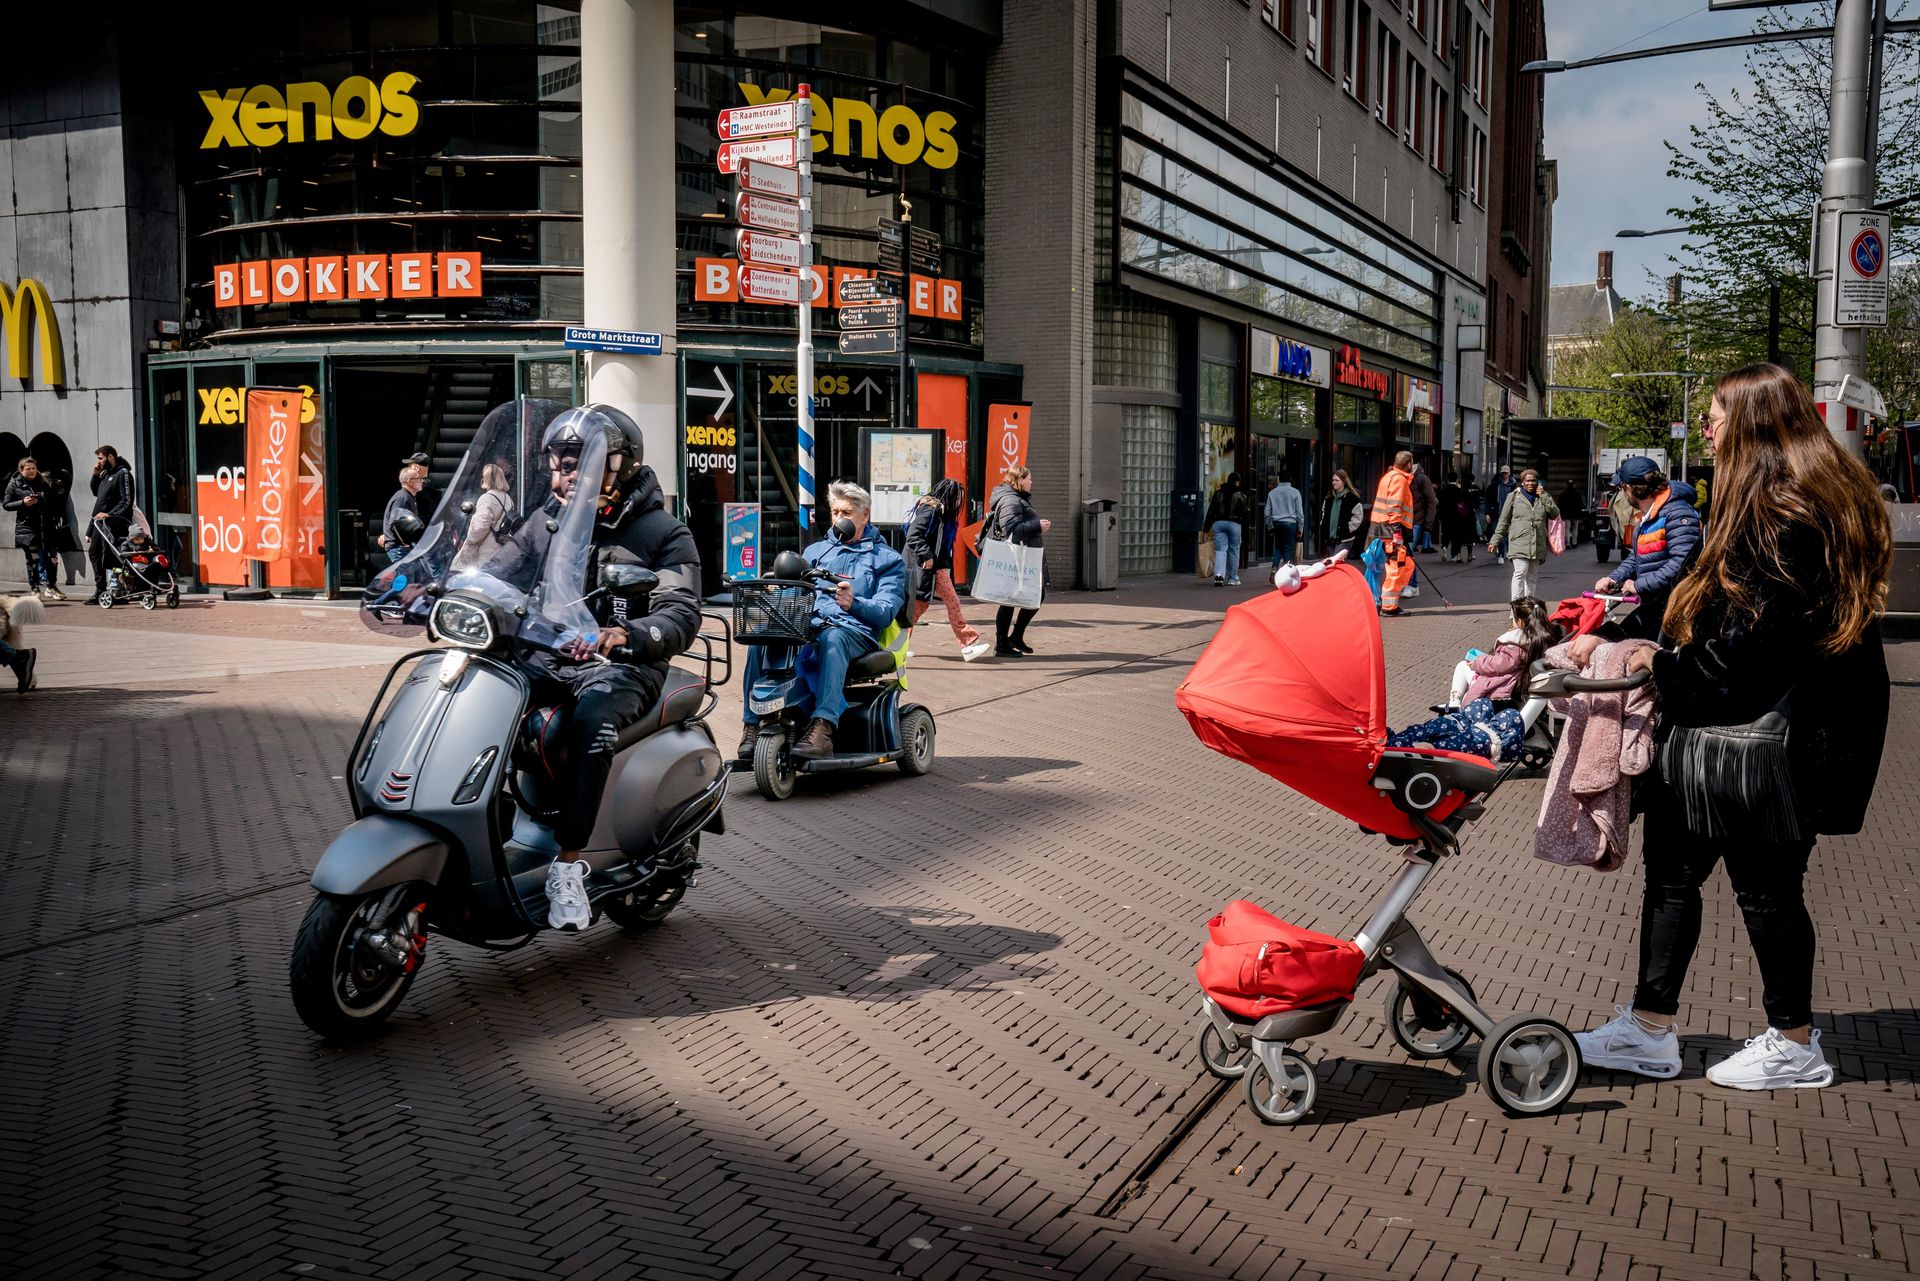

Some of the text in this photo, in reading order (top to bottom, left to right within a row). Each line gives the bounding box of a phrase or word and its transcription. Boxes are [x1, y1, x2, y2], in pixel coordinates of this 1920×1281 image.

[198, 71, 420, 149] xenos
[740, 108, 781, 120] Raamstraat
[740, 124, 753, 132] HMC
[755, 121, 787, 131] Westeinde
[731, 144, 760, 155] Kijkduin
[757, 178, 782, 190] Stadhuis
[757, 201, 778, 210] Centraal
[757, 214, 779, 225] Hollands
[781, 219, 795, 229] Spoor
[1860, 217, 1880, 227] ZONE
[751, 236, 778, 249] Voorburg
[751, 249, 793, 262] Leidschendam
[219, 258, 473, 300] BLOKKER
[752, 272, 784, 283] Zoetermeer
[752, 285, 780, 295] Rotterdam
[571, 330, 655, 344] Grote Marktstraat
[788, 396, 831, 408] oen
[686, 425, 736, 447] xenos
[686, 448, 737, 475] ingang
[256, 405, 289, 550] blokker
[987, 559, 1036, 575] PRIMRK
